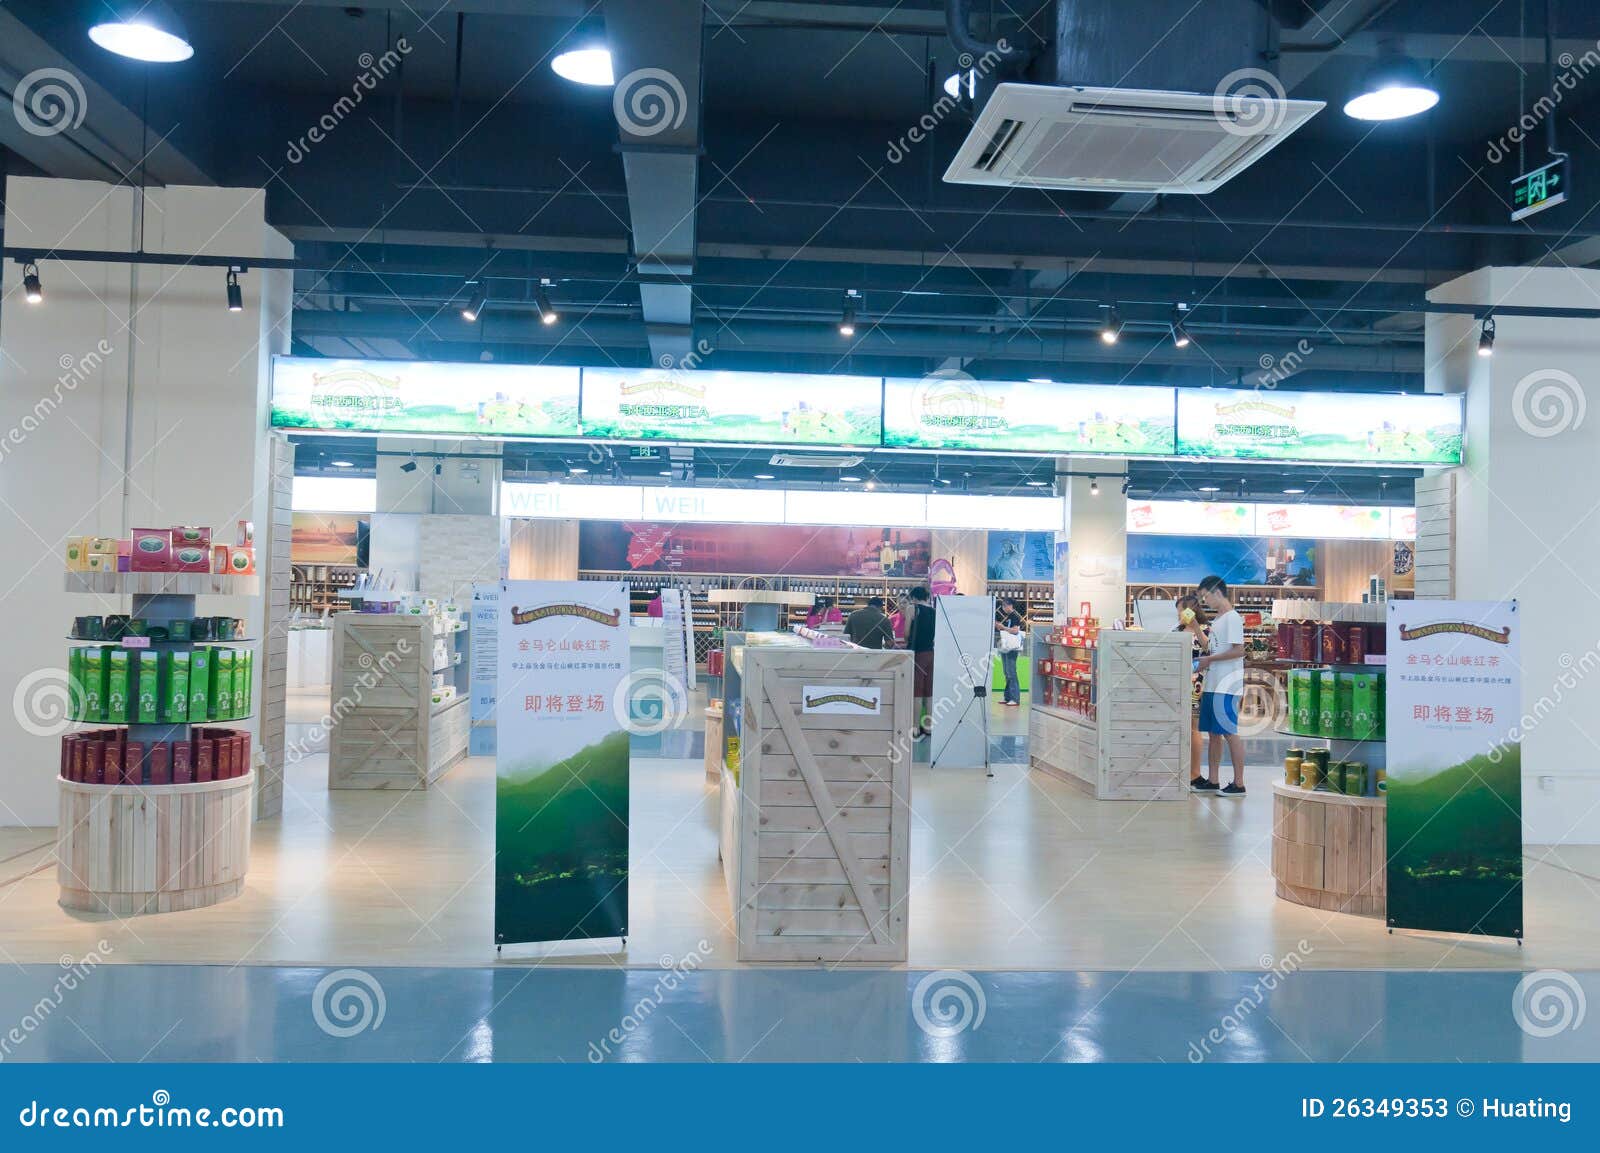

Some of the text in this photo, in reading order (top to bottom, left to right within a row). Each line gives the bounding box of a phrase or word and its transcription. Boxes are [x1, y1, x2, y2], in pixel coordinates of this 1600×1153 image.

[525, 694, 605, 713] 即将登场
[1413, 704, 1494, 724] 即将登场
